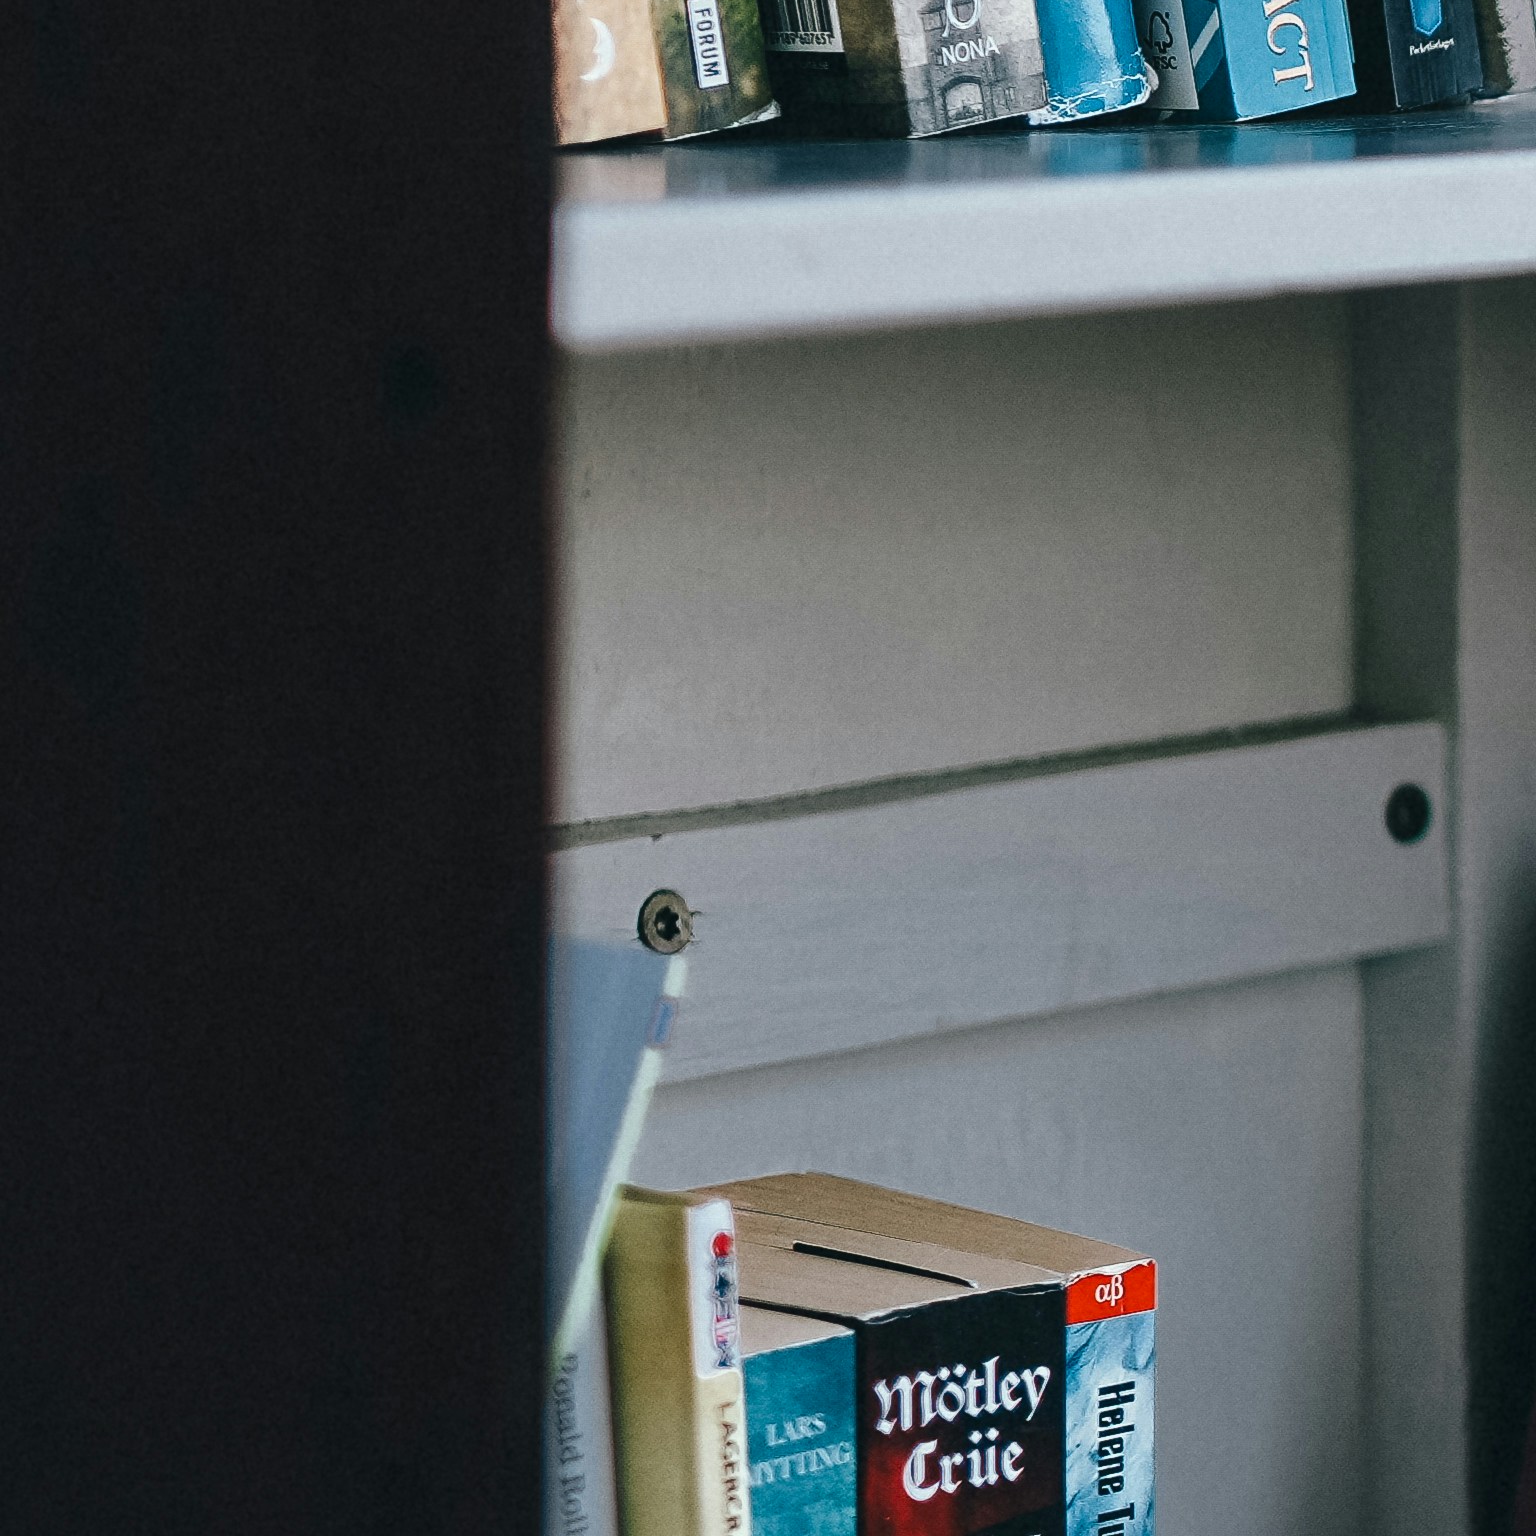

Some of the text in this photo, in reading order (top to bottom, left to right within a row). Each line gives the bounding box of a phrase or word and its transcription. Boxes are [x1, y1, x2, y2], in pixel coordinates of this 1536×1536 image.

[693, 5, 722, 80] FORUM
[940, 35, 1002, 67] NONA
[764, 1413, 828, 1448] LARS
[872, 1354, 1051, 1436] Mötley
[902, 1426, 1026, 1503] Crüe
[1097, 1380, 1137, 1497] Helene
